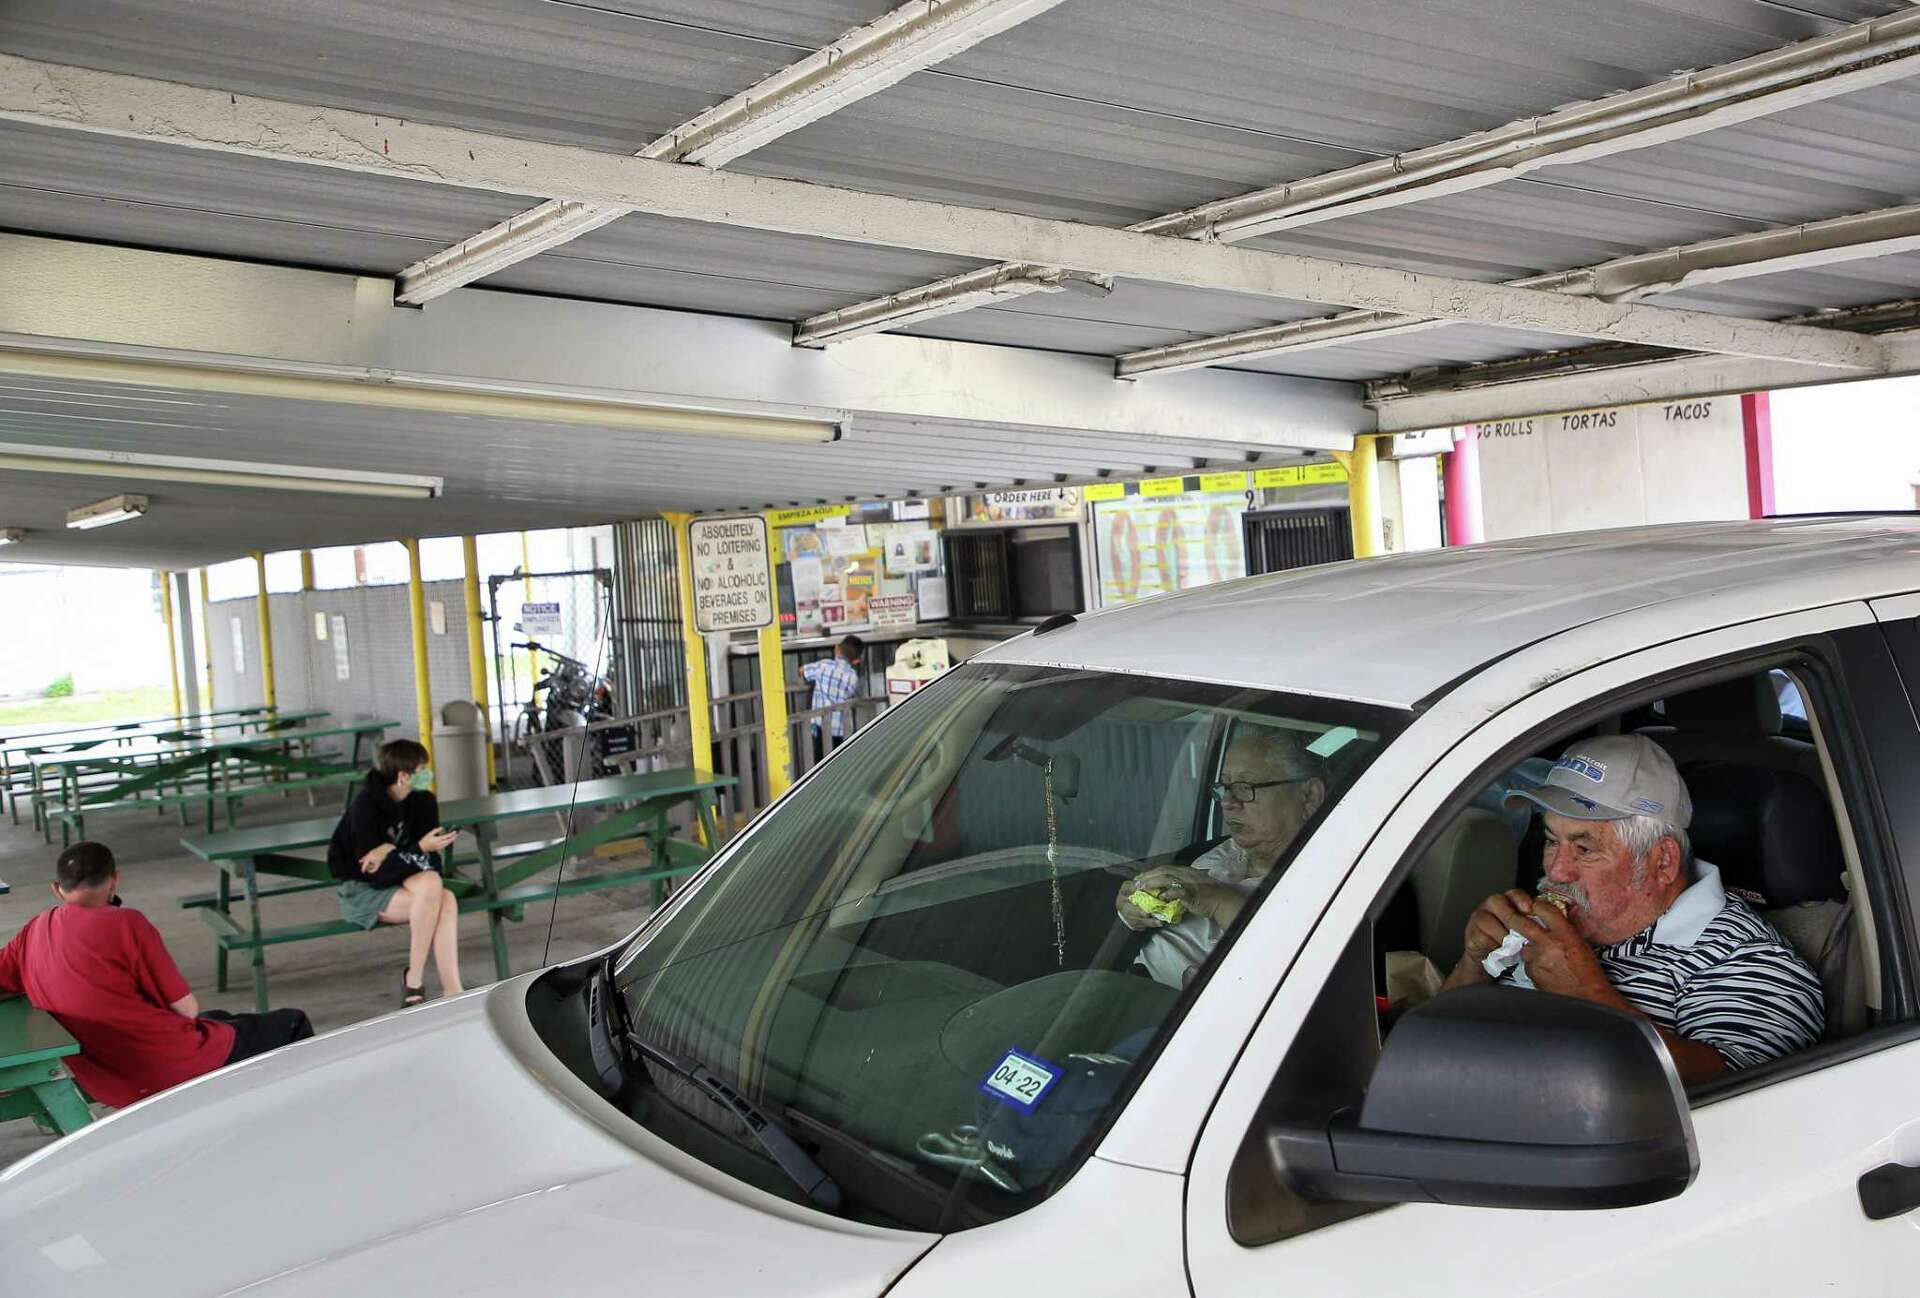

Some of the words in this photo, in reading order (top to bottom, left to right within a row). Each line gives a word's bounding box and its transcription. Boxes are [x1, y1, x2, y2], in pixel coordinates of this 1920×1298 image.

[1664, 402, 1712, 421] TACOS
[1495, 420, 1533, 438] ROLLS
[1561, 411, 1617, 431] TORTAS
[994, 491, 1027, 503] ORDER
[1029, 490, 1052, 502] HERE
[1245, 489, 1256, 511] 2
[778, 510, 812, 521] EMPIEZA
[702, 523, 754, 539] ABSOLUTELY
[697, 543, 710, 556] NO
[717, 539, 761, 555] LOITERING
[727, 557, 734, 570] &
[697, 577, 711, 590] NO
[718, 572, 766, 589] ALCOHOLIC
[523, 603, 557, 613] NOTICE
[699, 591, 748, 609] BEVERAGES
[754, 590, 767, 603] ON
[870, 597, 914, 609] WARNING
[712, 608, 757, 625] PREMISES
